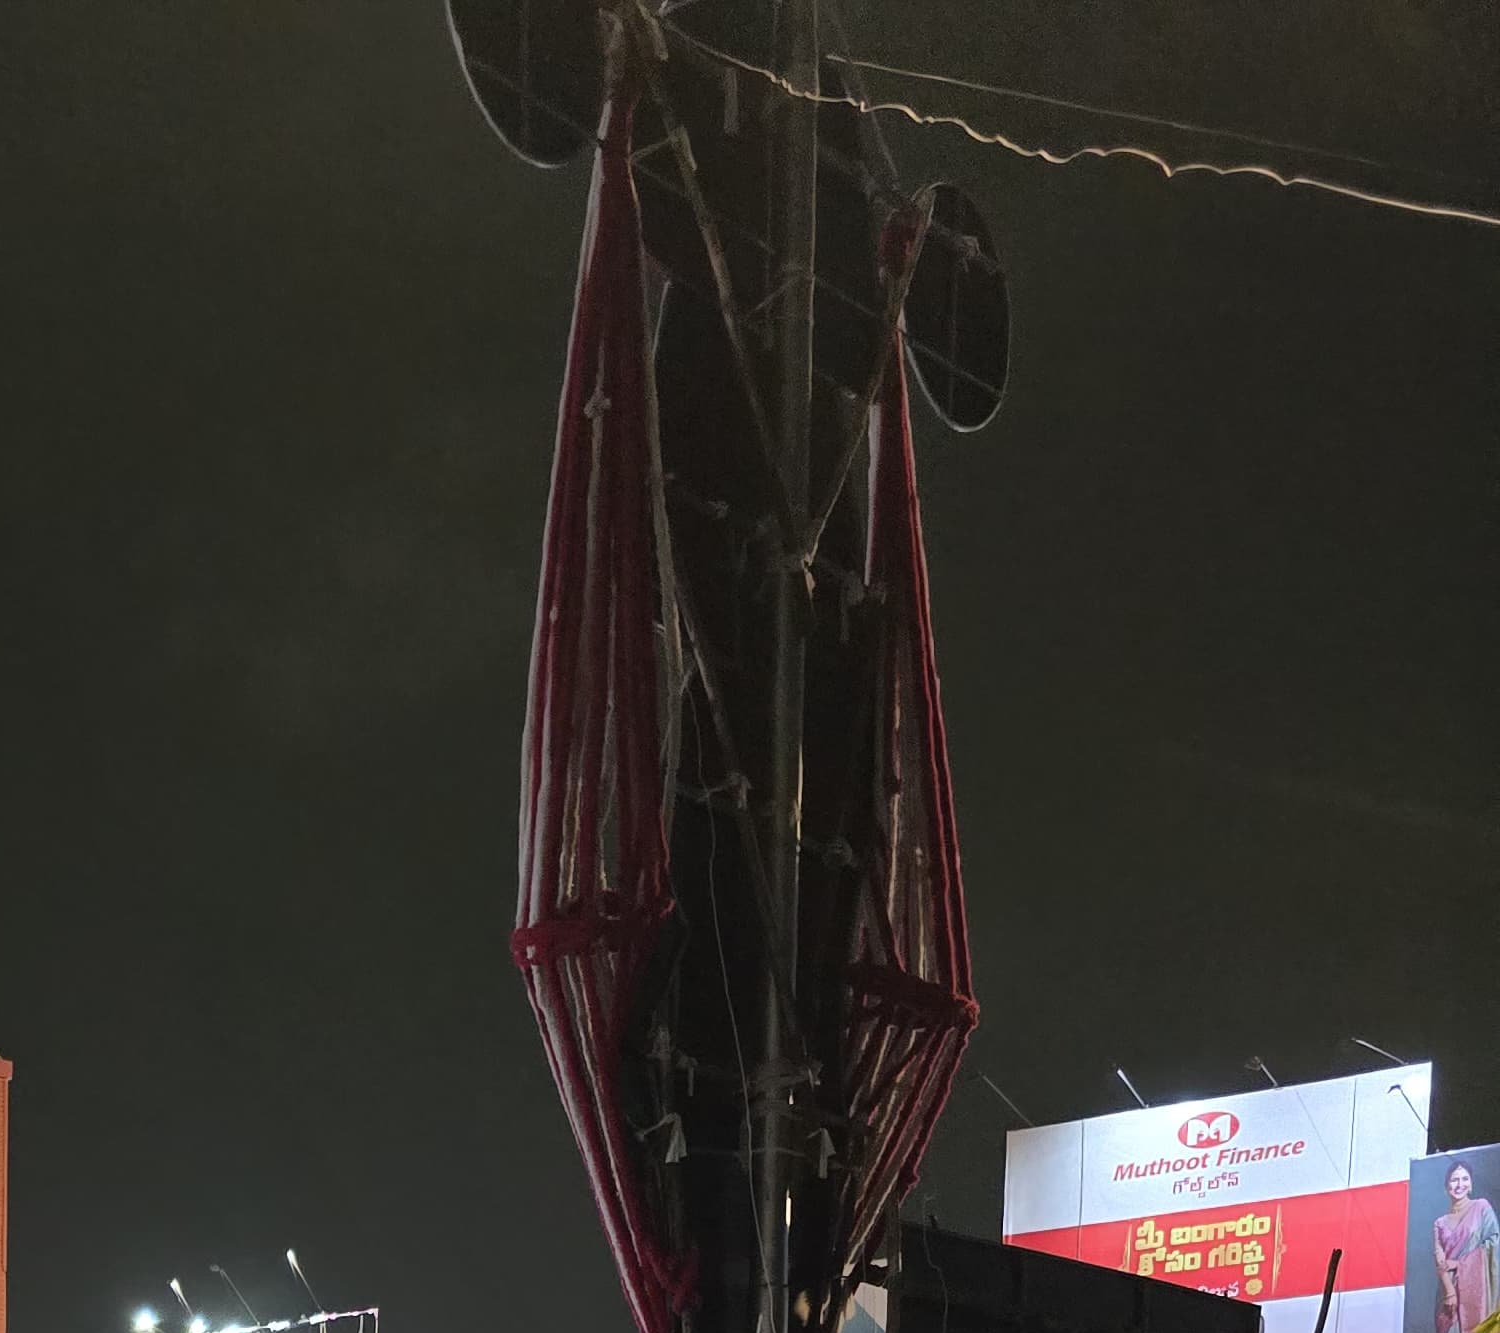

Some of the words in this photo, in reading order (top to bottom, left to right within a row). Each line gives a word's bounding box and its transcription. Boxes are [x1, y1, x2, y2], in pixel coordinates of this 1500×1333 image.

[1113, 1153, 1209, 1181] Muthoot
[1216, 1140, 1305, 1166] Finance
[1170, 1213, 1271, 1245] బంగారం
